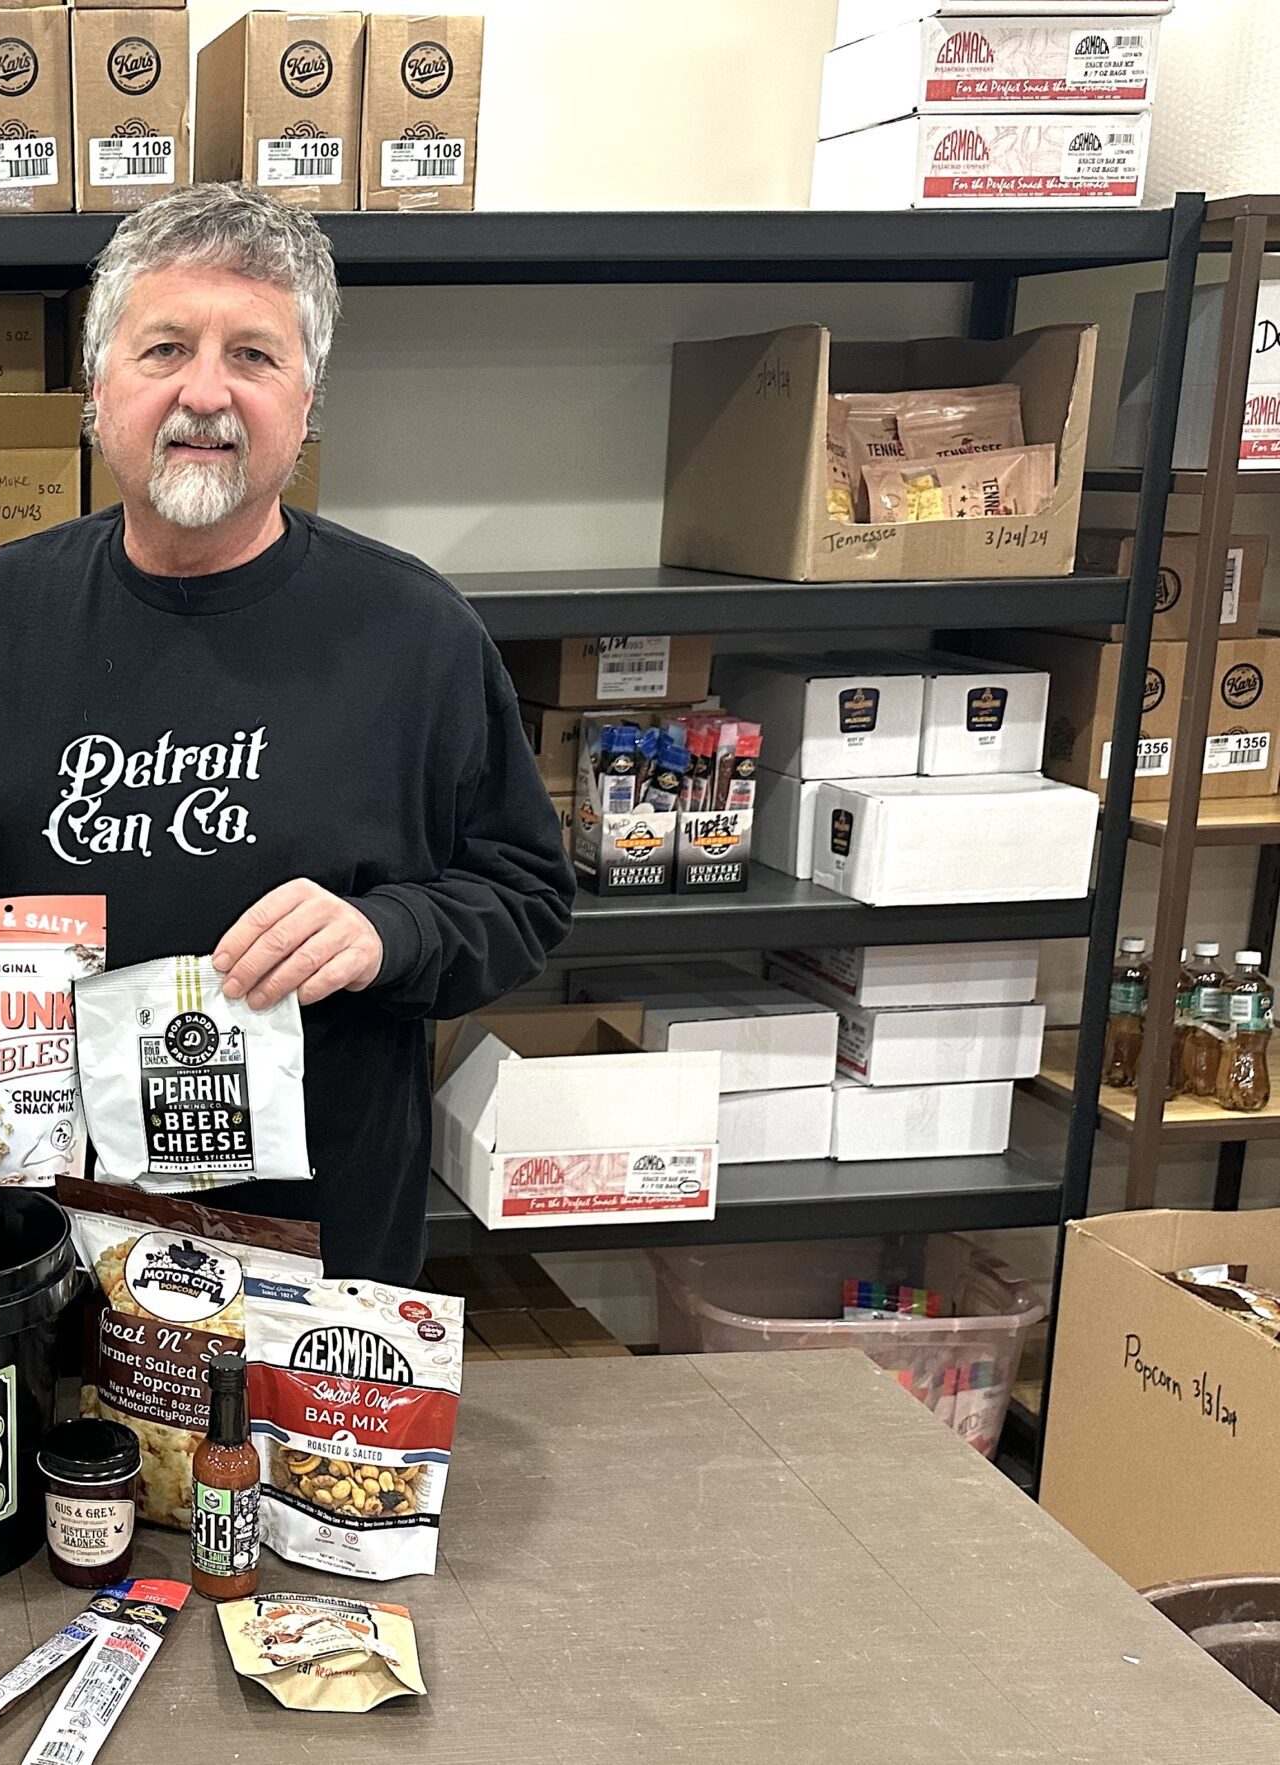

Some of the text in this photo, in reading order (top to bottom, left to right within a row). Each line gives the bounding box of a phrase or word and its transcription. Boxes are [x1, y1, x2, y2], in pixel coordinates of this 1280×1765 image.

[936, 30, 995, 64] GERMACK
[1074, 35, 1110, 55] GERMACK
[113, 51, 154, 76] Kar's
[286, 54, 326, 78] Kar's
[407, 55, 447, 78] Kar's
[956, 79, 1050, 95] For the Perfect Snack
[14, 142, 54, 159] 1108
[131, 141, 171, 157] 1108
[300, 142, 339, 157] 1108
[423, 143, 462, 159] 1108
[933, 129, 990, 161] GERMACK
[1068, 132, 1103, 152] GERMACK
[952, 177, 1045, 191] For the Perfect Snack
[6, 331, 13, 341] 5
[1251, 440, 1268, 453] For
[38, 483, 45, 495] 5
[47, 483, 64, 495] OZ.
[823, 524, 1048, 553] Tennessee 3/24/24
[1226, 676, 1258, 694] Kar's
[1137, 741, 1169, 755] 1356
[1235, 736, 1267, 749] 1356
[58, 726, 269, 800] Detroit
[42, 786, 258, 866] Can Co.
[612, 866, 663, 877] HUNTERS
[689, 872, 738, 883] SAUSAGE
[690, 863, 741, 875] HUNTERS
[612, 874, 662, 885] SAUSAGE
[3, 912, 89, 936] & SALTY
[167, 1014, 216, 1039] POP DADDY
[170, 1045, 215, 1064] PRETZELS
[11, 1088, 76, 1103] CRUNCHY
[148, 1073, 243, 1110] PERRIN
[14, 1103, 54, 1115] SNACK
[164, 1110, 230, 1131] BEER
[153, 1131, 247, 1153] CHEESE
[204, 1153, 237, 1161] STICKS
[510, 1158, 564, 1186] GERMACK
[530, 1198, 545, 1209] For
[548, 1197, 560, 1208] the
[562, 1196, 591, 1208] Perfect
[144, 1269, 221, 1295] MOTOR CITY
[160, 1282, 200, 1297] POPCORN
[99, 1306, 193, 1353] Sweet N'
[293, 1328, 409, 1383] GERMACK
[145, 1356, 197, 1382] Salted
[109, 1379, 167, 1407] Net Weight:
[133, 1371, 202, 1399] Popcorn
[313, 1381, 361, 1405] Snack
[1124, 1334, 1237, 1437] Popcorn 3/3/24
[305, 1408, 389, 1433] BAR MIX
[307, 1439, 383, 1462] ROASTED & SALTED
[55, 1502, 73, 1516] GUS
[75, 1507, 83, 1517] &
[60, 1524, 108, 1539] MISTLETOE
[196, 1510, 231, 1550] 313
[63, 1535, 107, 1548] MADNESS
[208, 1551, 231, 1562] SAUCE
